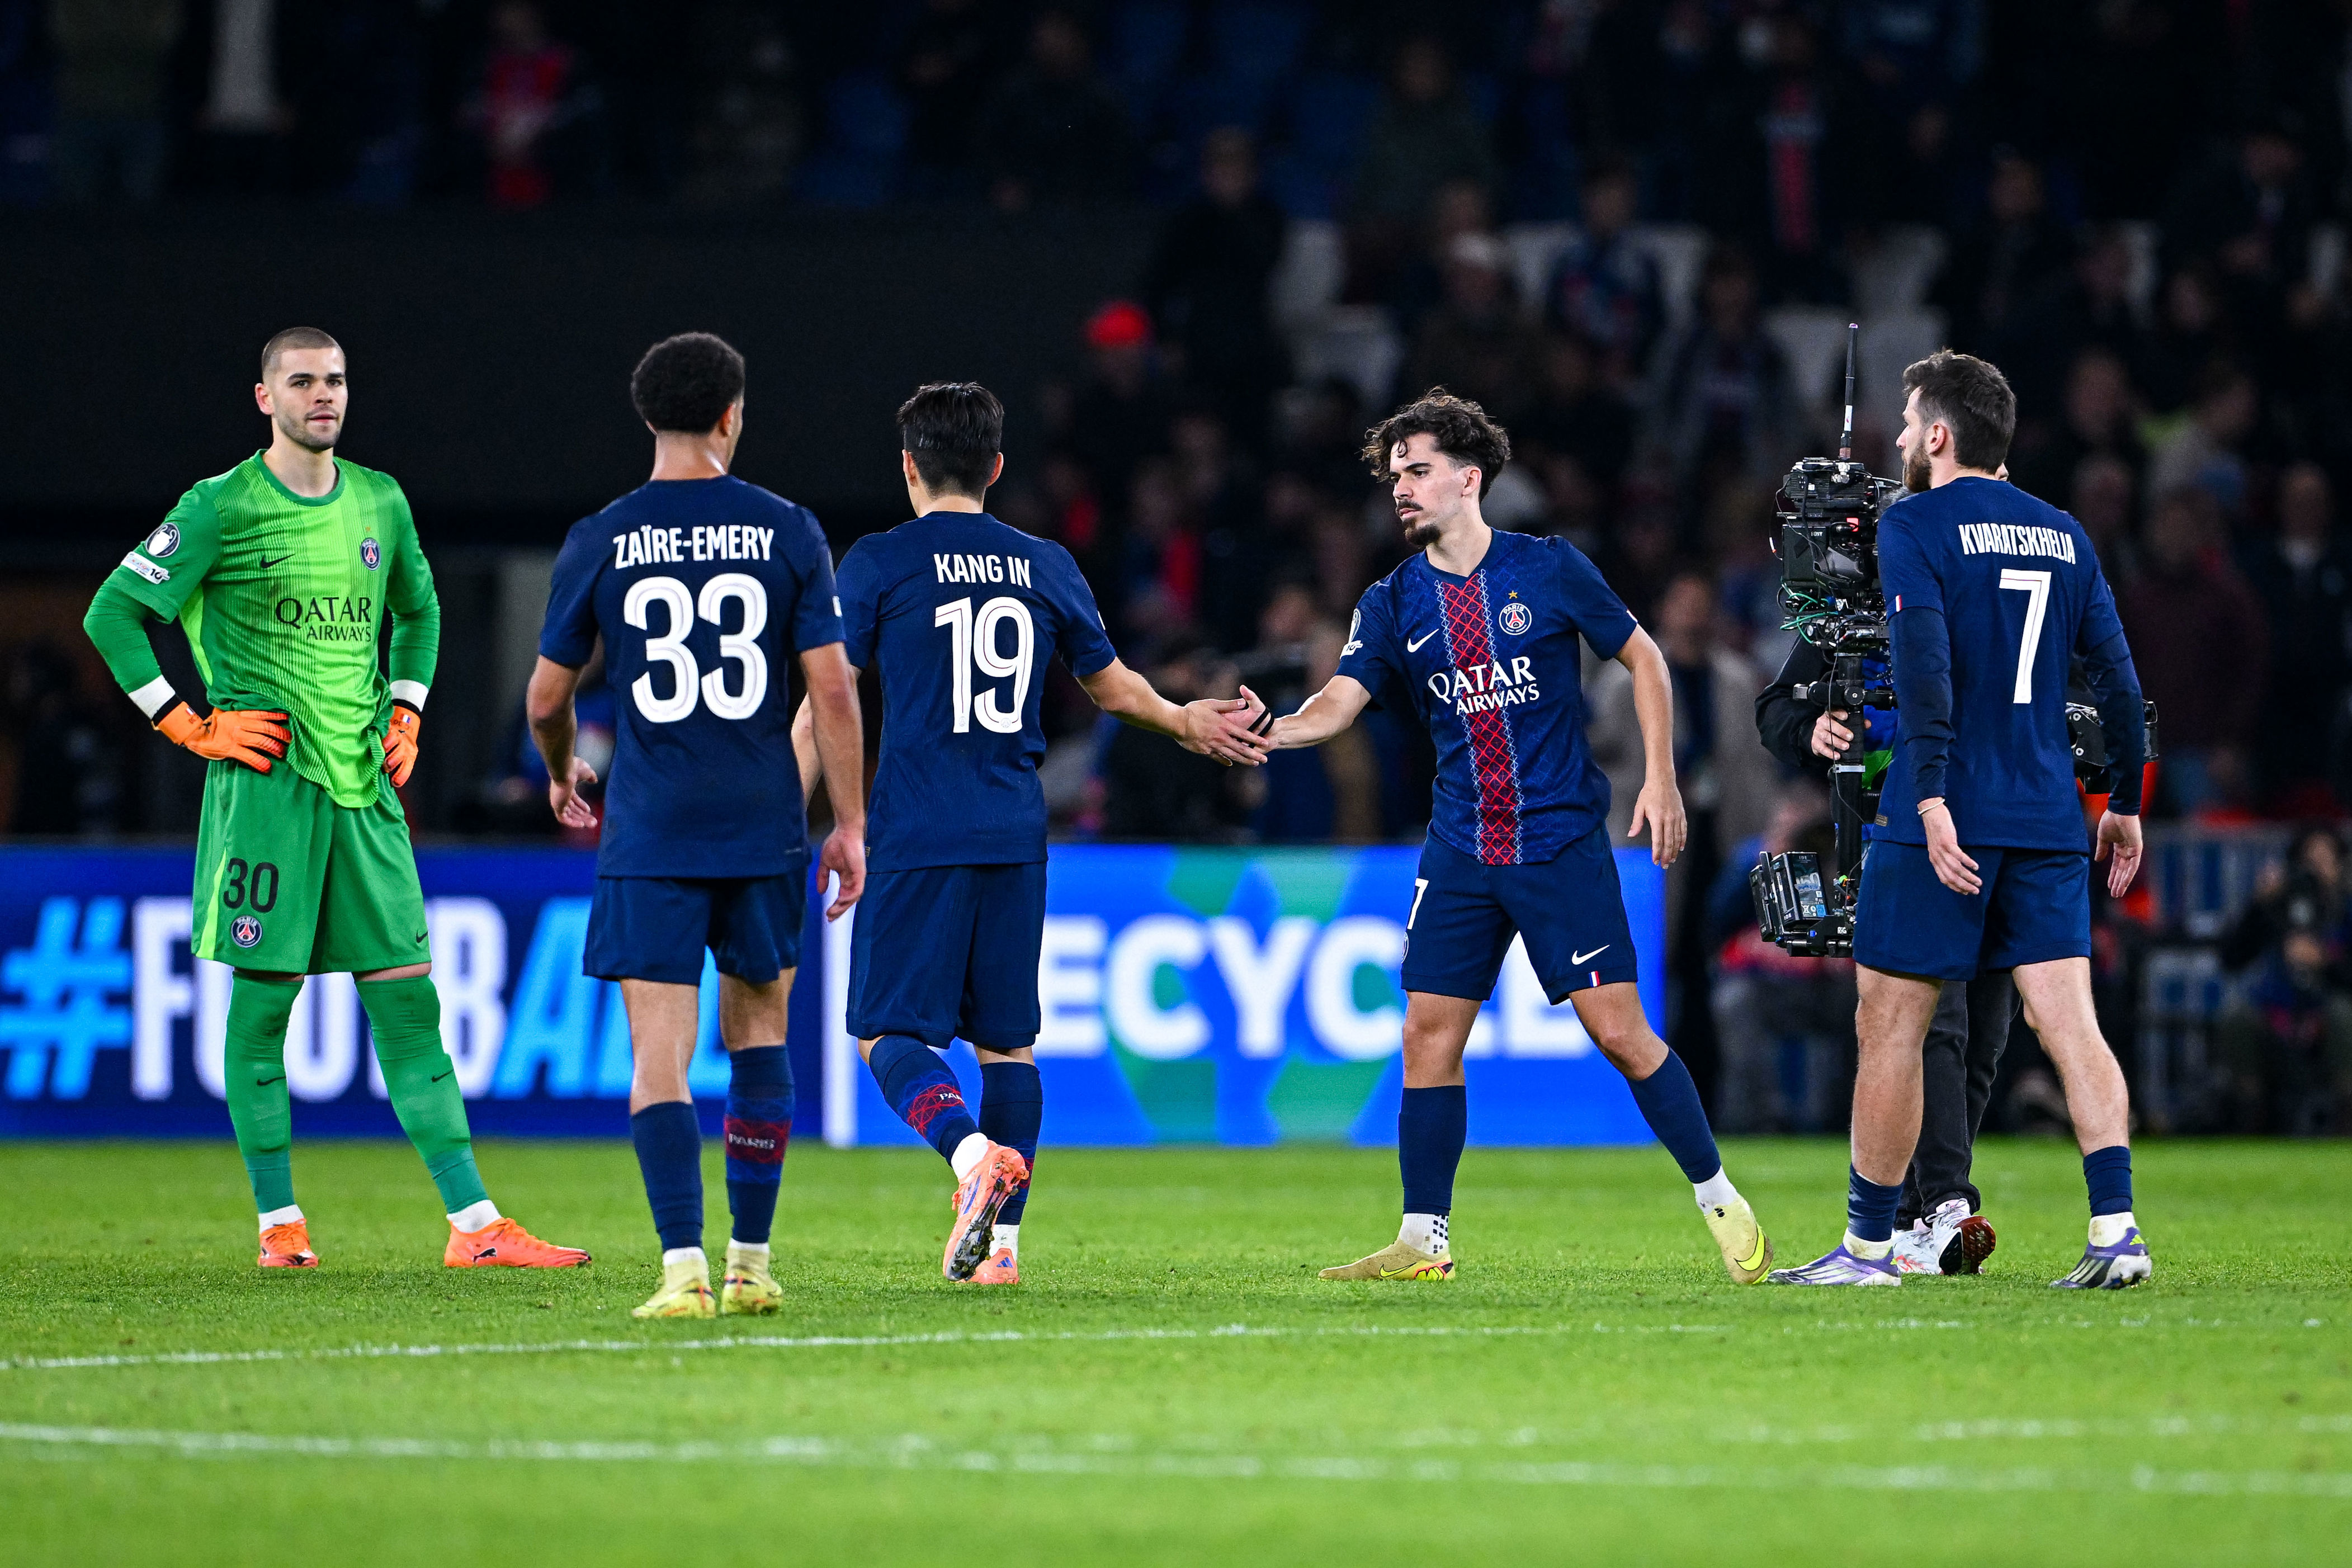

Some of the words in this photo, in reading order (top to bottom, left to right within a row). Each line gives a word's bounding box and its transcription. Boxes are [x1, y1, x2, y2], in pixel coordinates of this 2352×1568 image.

[613, 525, 774, 569] ZAÏRE-EMERY
[1958, 523, 2076, 565] KVARATSKHELIA
[933, 554, 1004, 583] KANG
[1007, 556, 1032, 588] IN
[276, 597, 371, 629] QATAR
[1503, 604, 1525, 614] PARIS
[307, 625, 371, 641] AIRWAYS
[624, 573, 768, 723] 33
[1999, 569, 2052, 704] 7
[934, 597, 1034, 733] 19
[1428, 657, 1537, 705] QATAR
[1456, 683, 1539, 715] AIRWAYS
[224, 857, 279, 913] 30
[237, 917, 258, 927] PARIS
